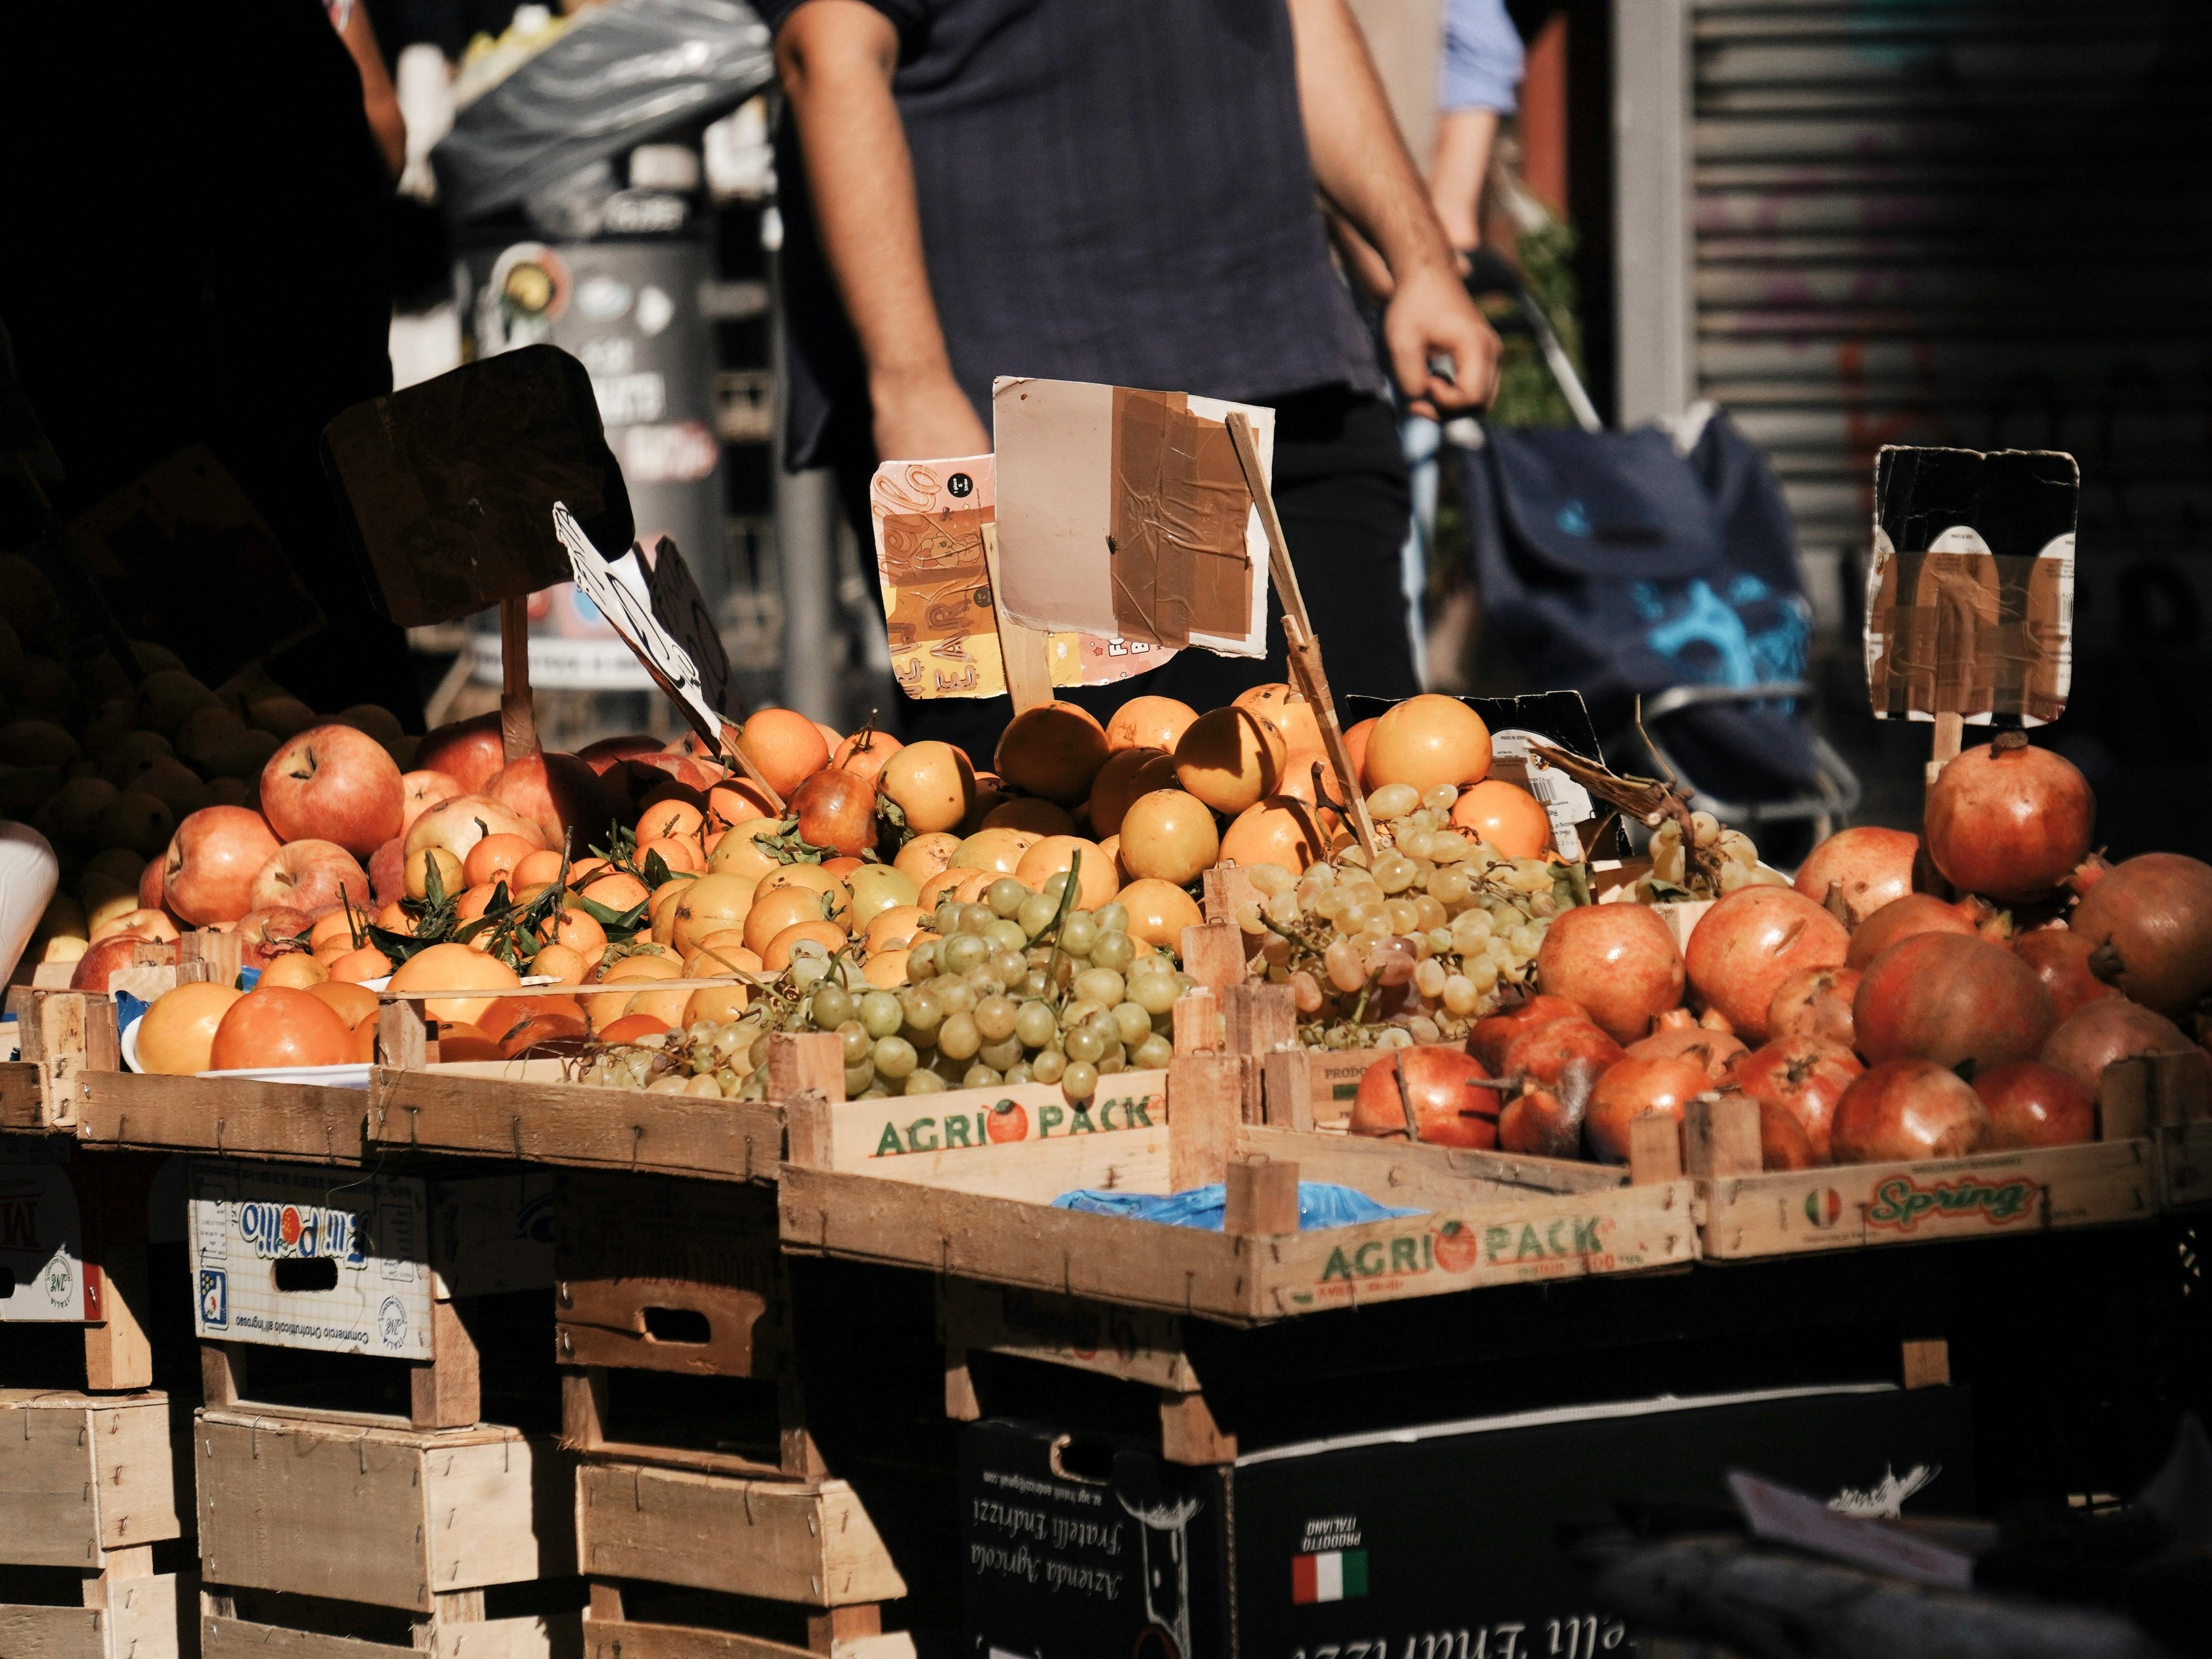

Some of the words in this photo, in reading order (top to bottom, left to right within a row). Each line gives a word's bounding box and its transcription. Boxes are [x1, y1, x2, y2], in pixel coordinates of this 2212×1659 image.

[1038, 1095, 1154, 1138] PACK
[1868, 1178, 2033, 1228] Spring
[1486, 1216, 1603, 1261] PACK
[51, 1297, 70, 1308] ITALIA
[275, 1321, 322, 1338] Ortofrutticolo
[324, 1328, 369, 1345] Commercio
[974, 1499, 1048, 1541] Endrizzi
[1052, 1519, 1123, 1556] Fratelli
[1306, 1516, 1357, 1536] ITALIANO
[1302, 1532, 1361, 1552] PRODOTTO
[970, 1543, 1041, 1583] Agricola
[1046, 1561, 1123, 1601] Azienda
